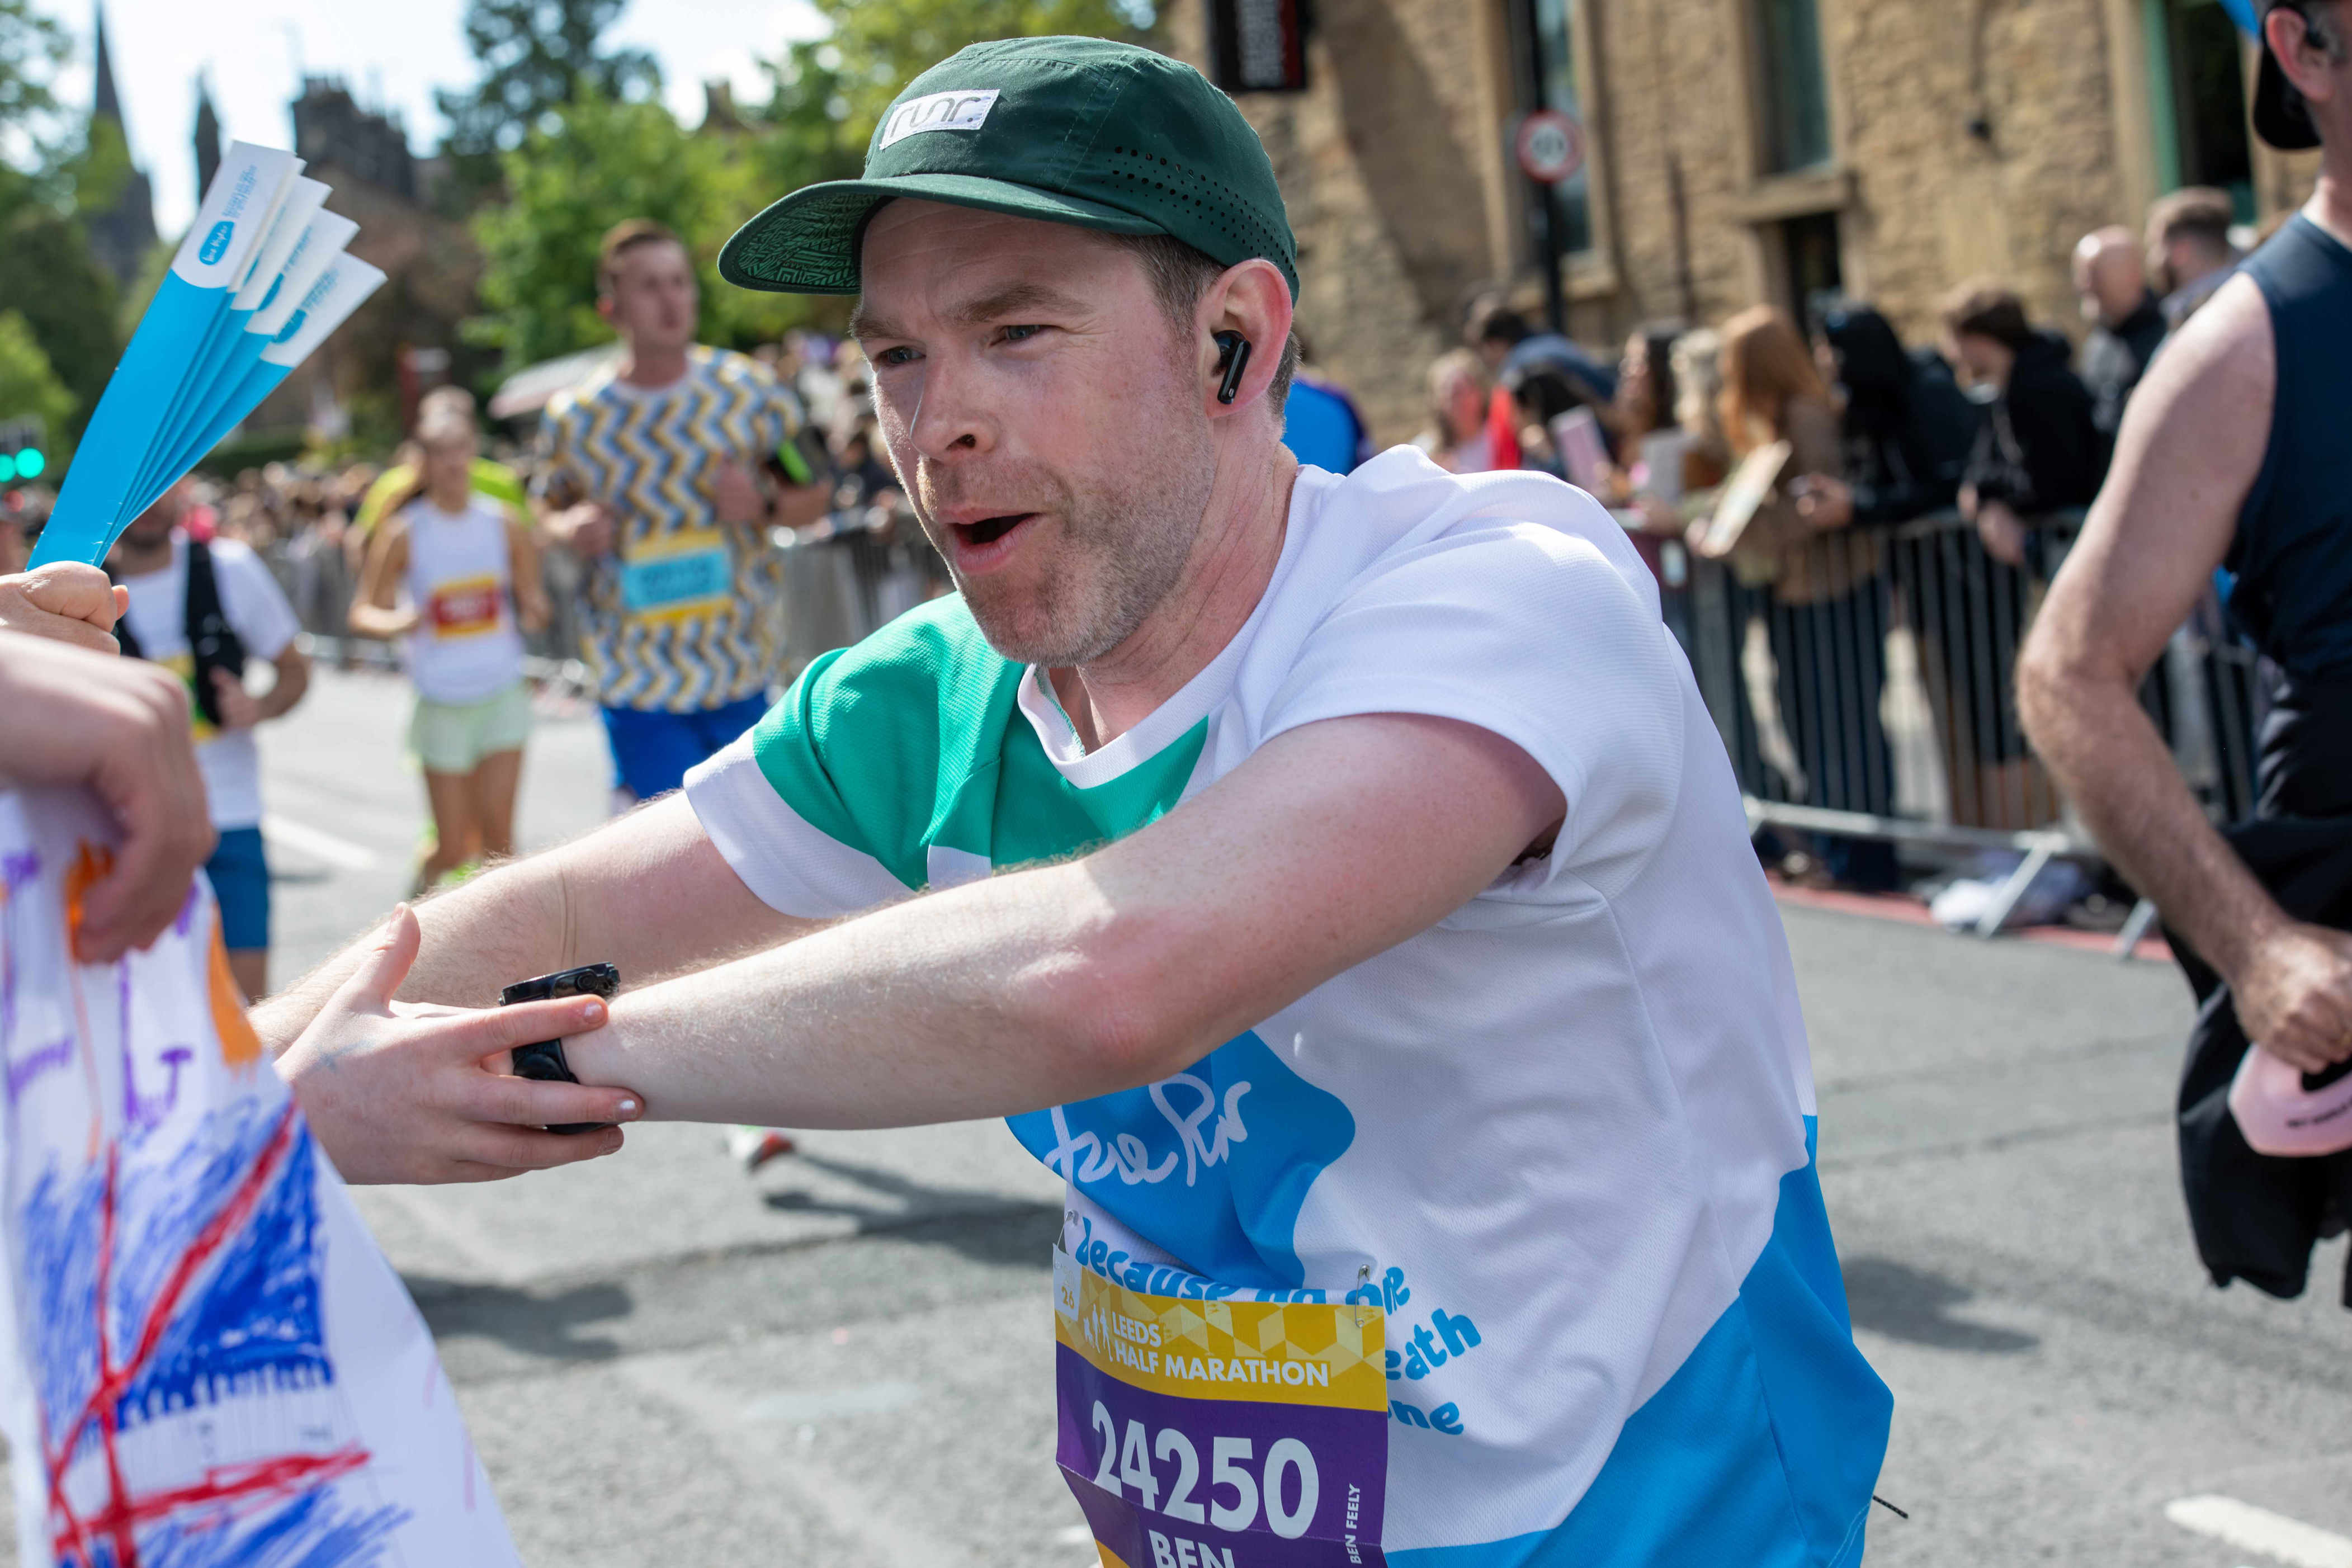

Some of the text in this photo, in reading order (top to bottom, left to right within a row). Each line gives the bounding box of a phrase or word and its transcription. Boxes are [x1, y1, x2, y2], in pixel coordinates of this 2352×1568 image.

[1112, 1311, 1161, 1347] LEEDS
[1114, 1340, 1329, 1387] HALF MARATHON
[1386, 1308, 1482, 1380] eath
[1092, 1400, 1320, 1539] 24250
[1345, 1482, 1362, 1565] BEN FEELY
